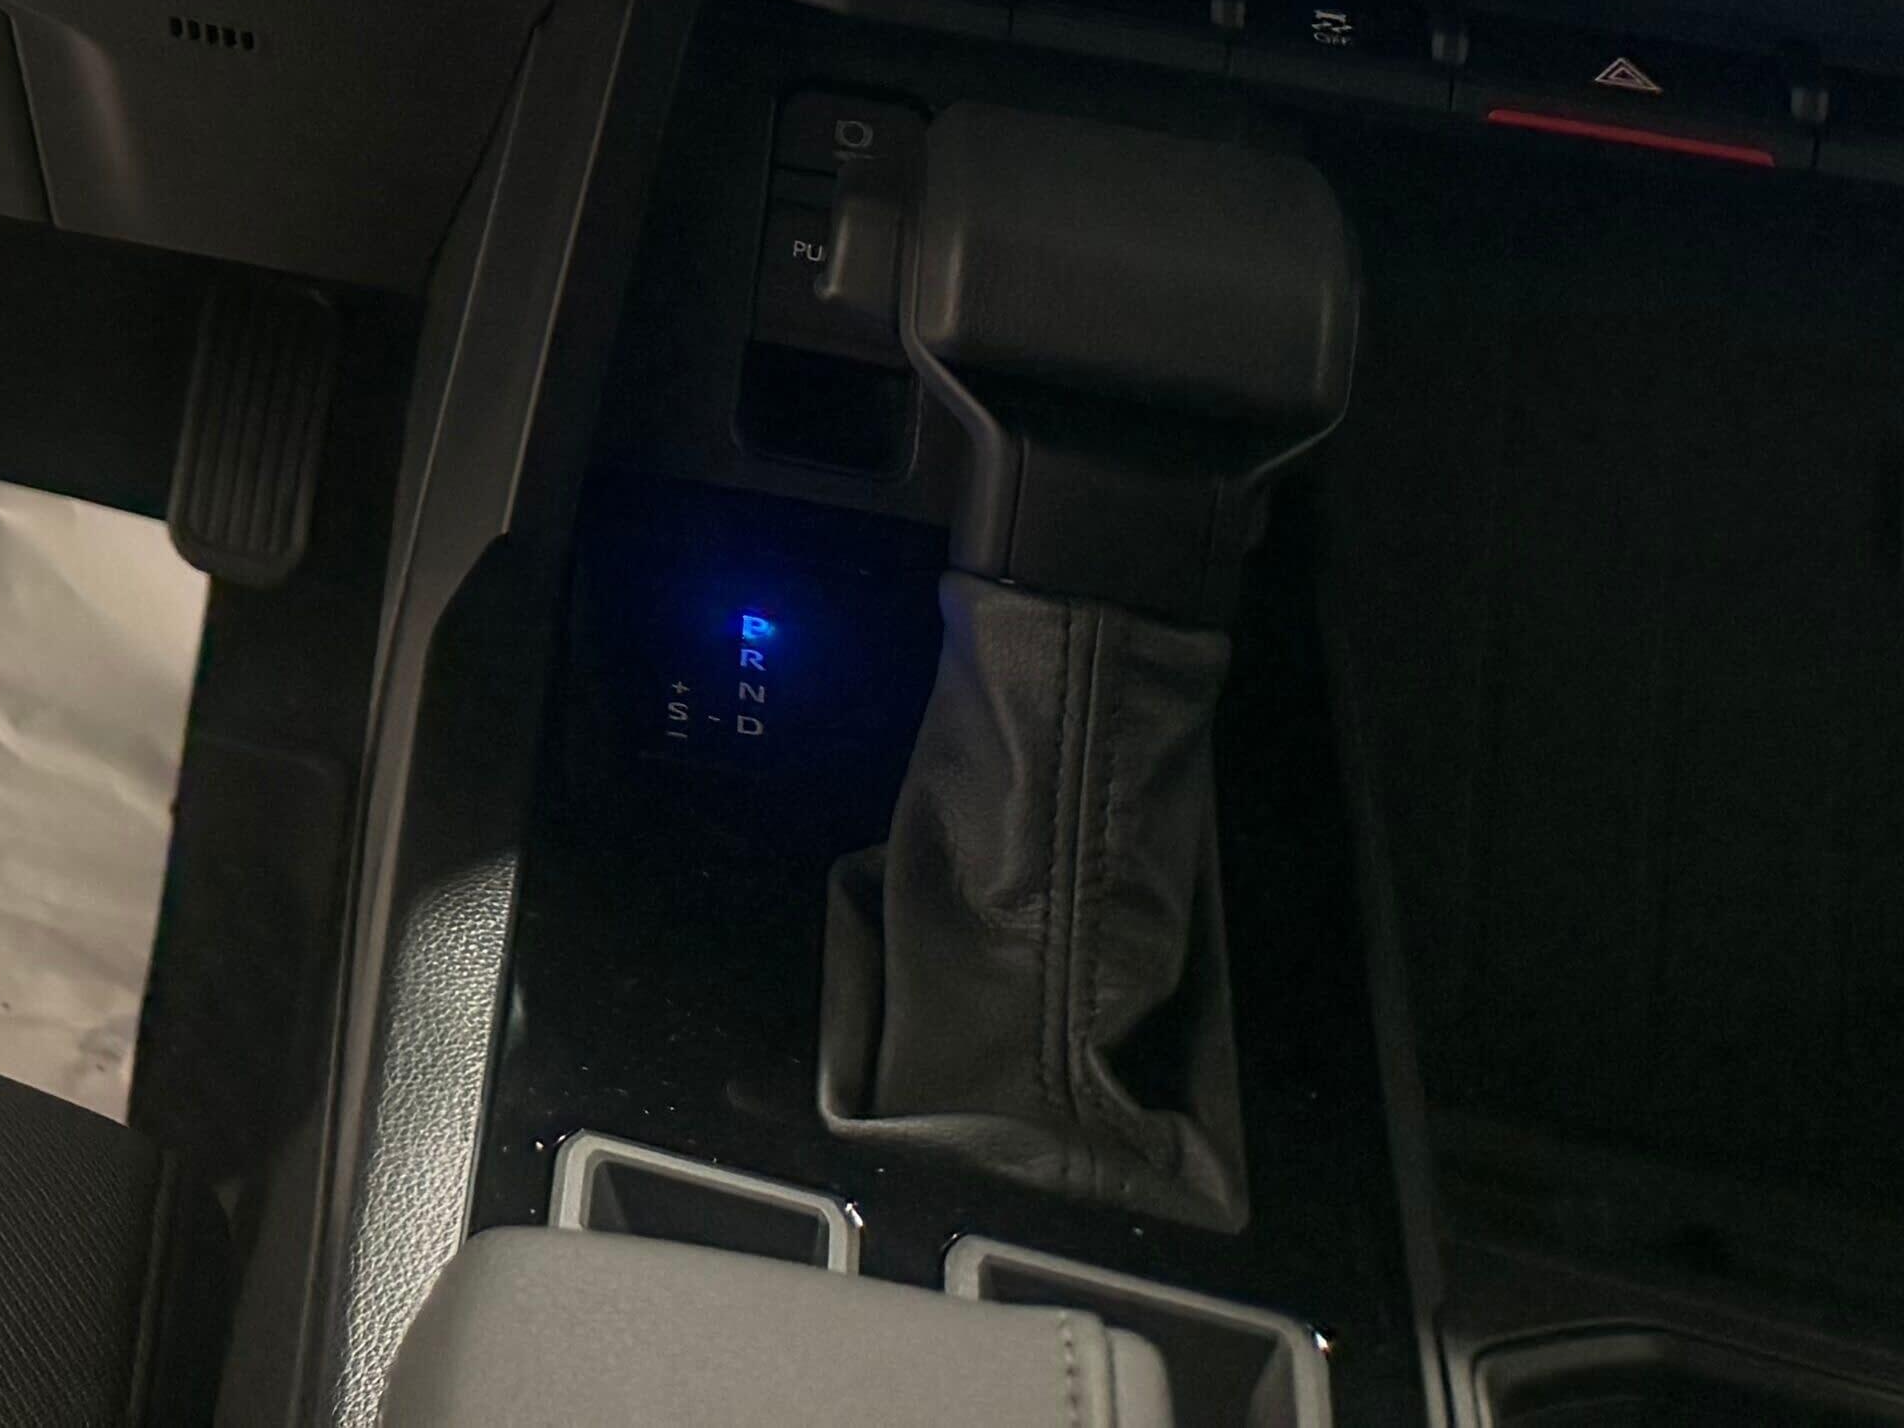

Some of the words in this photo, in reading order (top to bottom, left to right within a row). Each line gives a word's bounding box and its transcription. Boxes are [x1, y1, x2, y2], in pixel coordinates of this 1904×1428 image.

[742, 614, 769, 639] P
[740, 648, 767, 671] R
[738, 681, 765, 704] N
[667, 702, 689, 721] S
[736, 714, 765, 736] D
